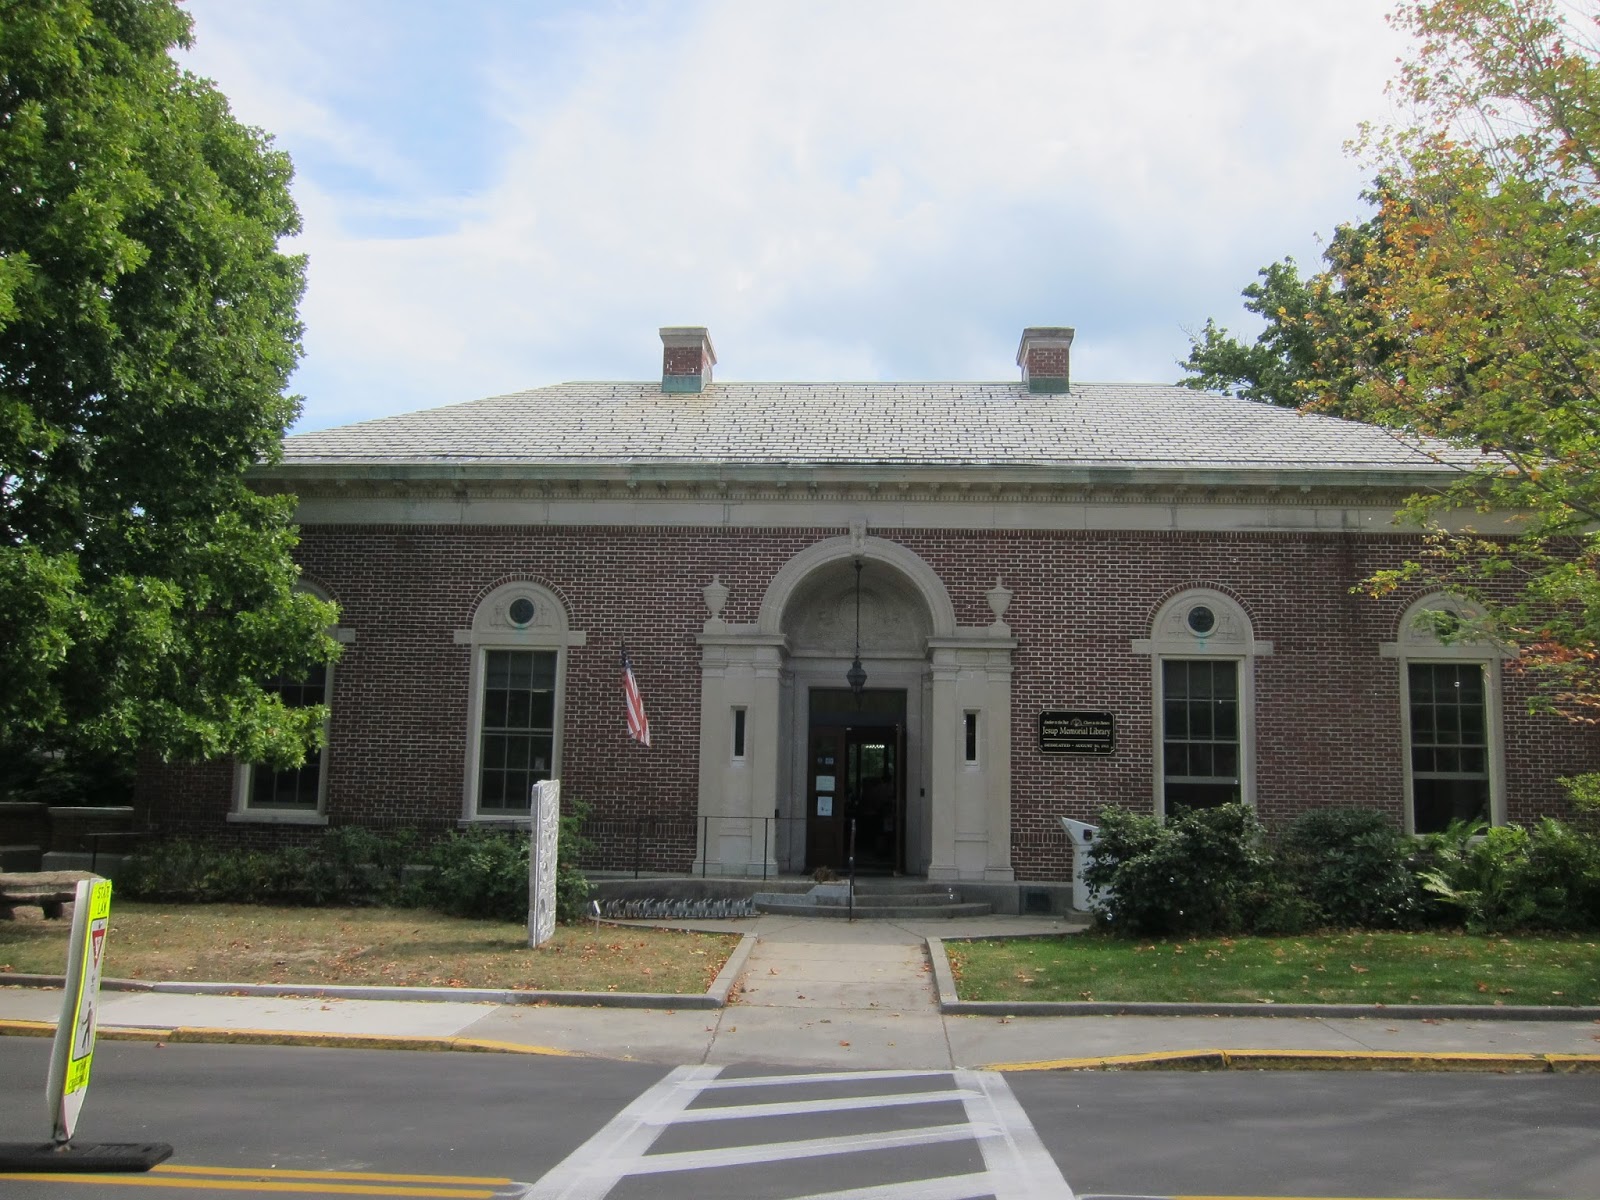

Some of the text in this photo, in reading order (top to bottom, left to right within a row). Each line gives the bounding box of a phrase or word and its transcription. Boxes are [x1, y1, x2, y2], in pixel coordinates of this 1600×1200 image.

[1042, 726, 1111, 737] Jesup Memorial Library
